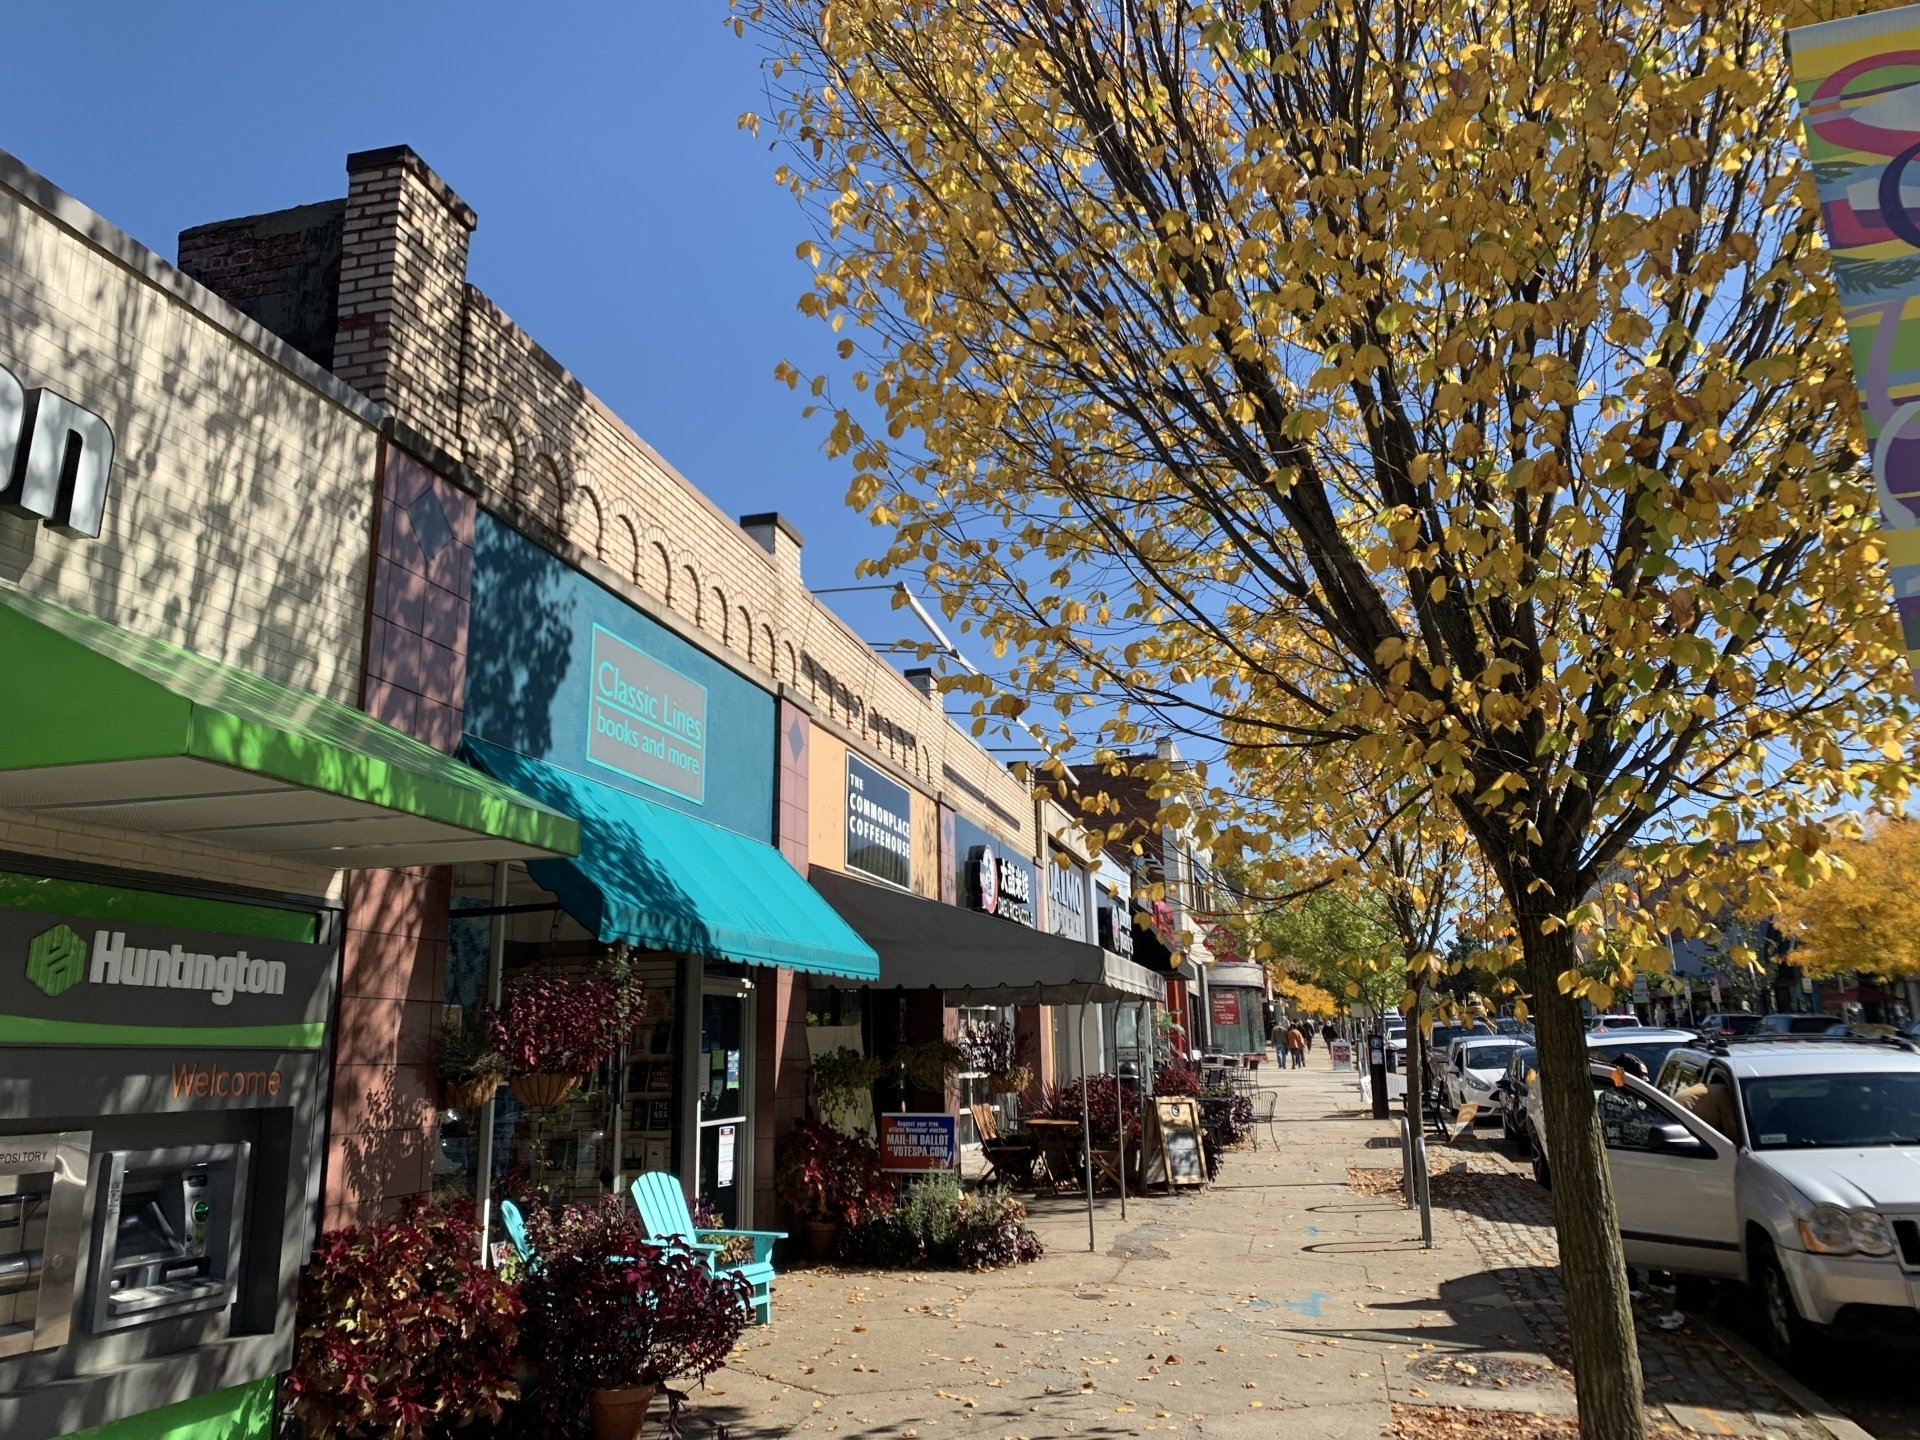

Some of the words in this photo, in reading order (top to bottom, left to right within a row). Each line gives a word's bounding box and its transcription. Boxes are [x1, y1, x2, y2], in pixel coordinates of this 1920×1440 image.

[598, 661, 658, 720] Classic
[663, 693, 702, 741] Lines
[596, 706, 639, 749] books
[642, 735, 665, 760] and
[668, 747, 700, 776] more
[849, 773, 864, 791] THE
[849, 792, 910, 839] COMMONPLACE
[849, 815, 910, 859] COFFEEHOUSE
[89, 930, 286, 1006] Huntington
[172, 1063, 281, 1098] Welcome
[653, 1110, 668, 1119] NRA
[654, 1101, 668, 1110] THE
[886, 1134, 918, 1145] MAIL-IN
[920, 1134, 949, 1146] BALLOT
[893, 1145, 948, 1157] VOTESPA.COM
